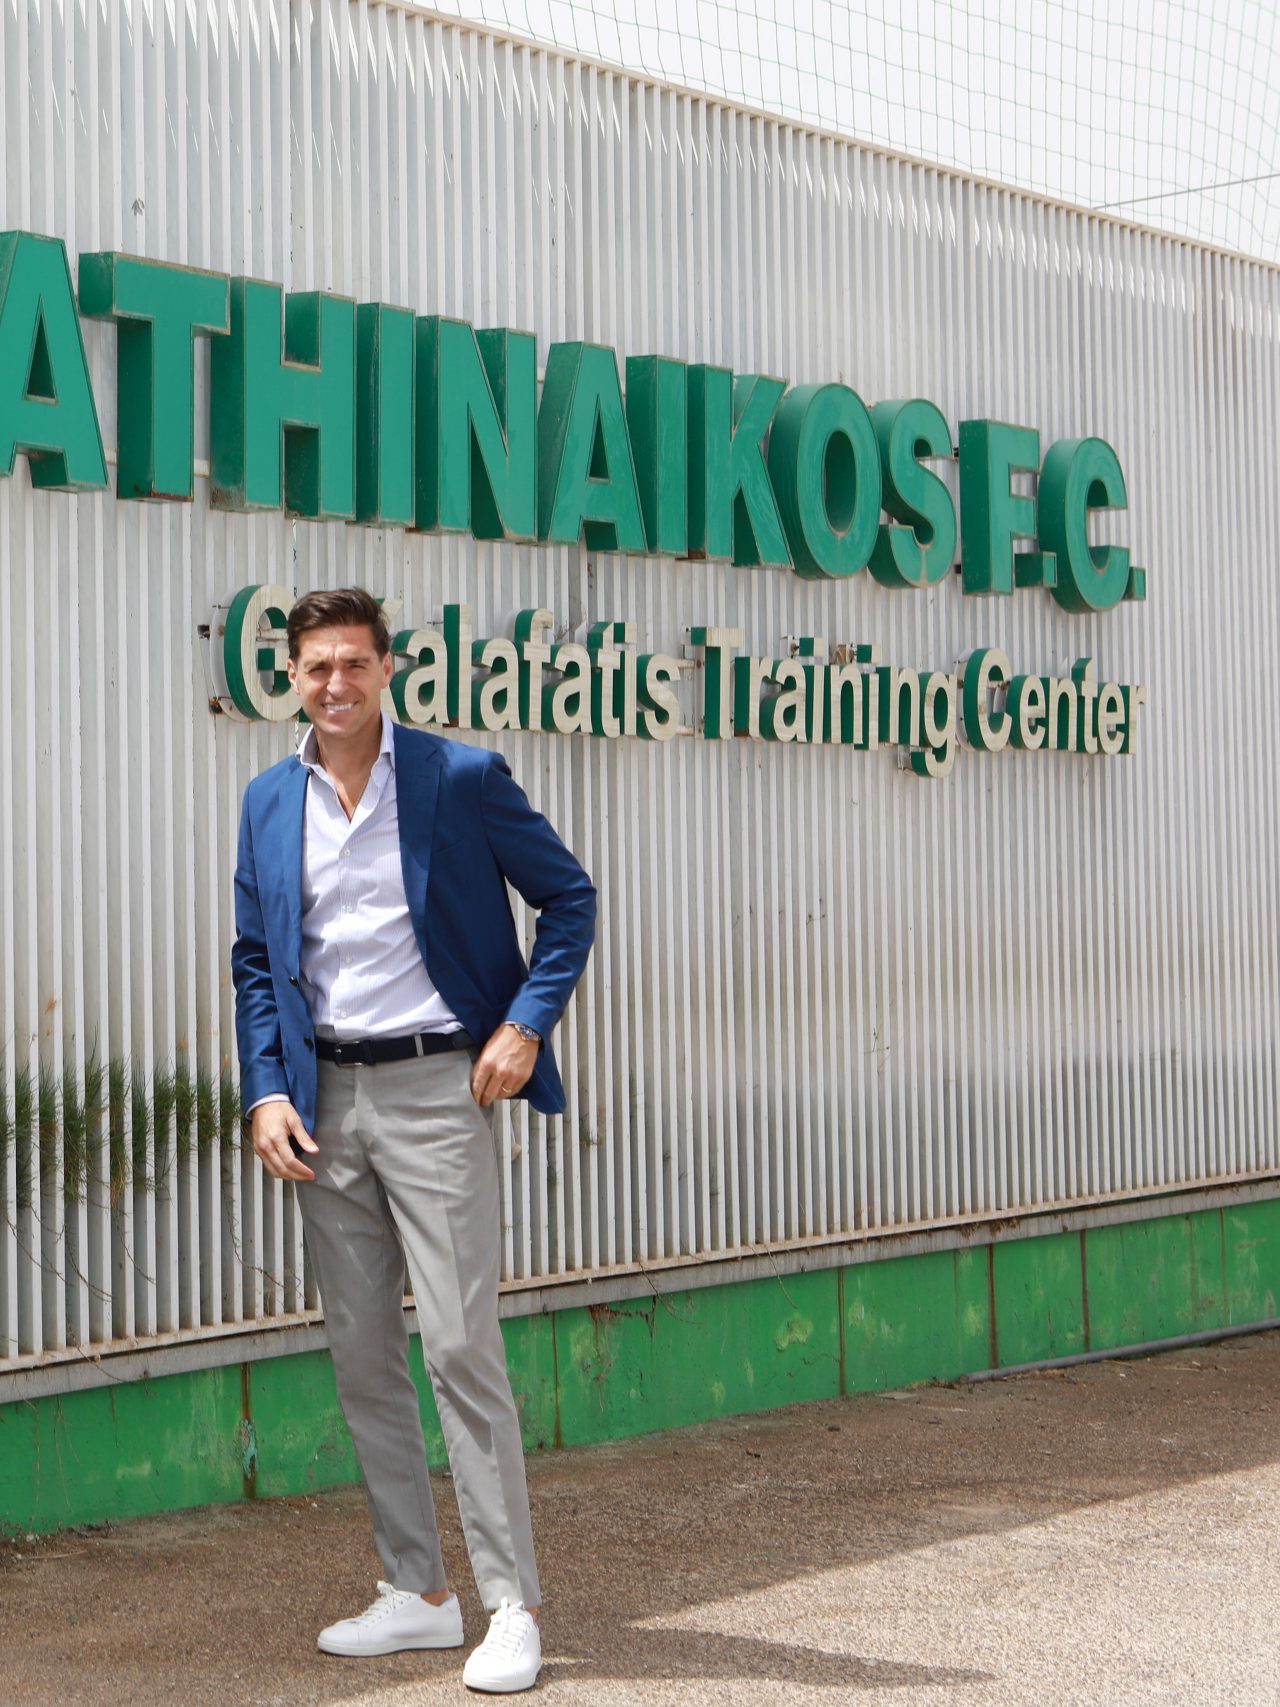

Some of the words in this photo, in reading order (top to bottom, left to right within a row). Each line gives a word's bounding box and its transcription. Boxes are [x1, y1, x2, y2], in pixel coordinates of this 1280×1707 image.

[958, 419, 1146, 614] F.C.
[223, 584, 313, 723] G
[690, 626, 957, 778] Training
[963, 647, 1146, 755] Center
